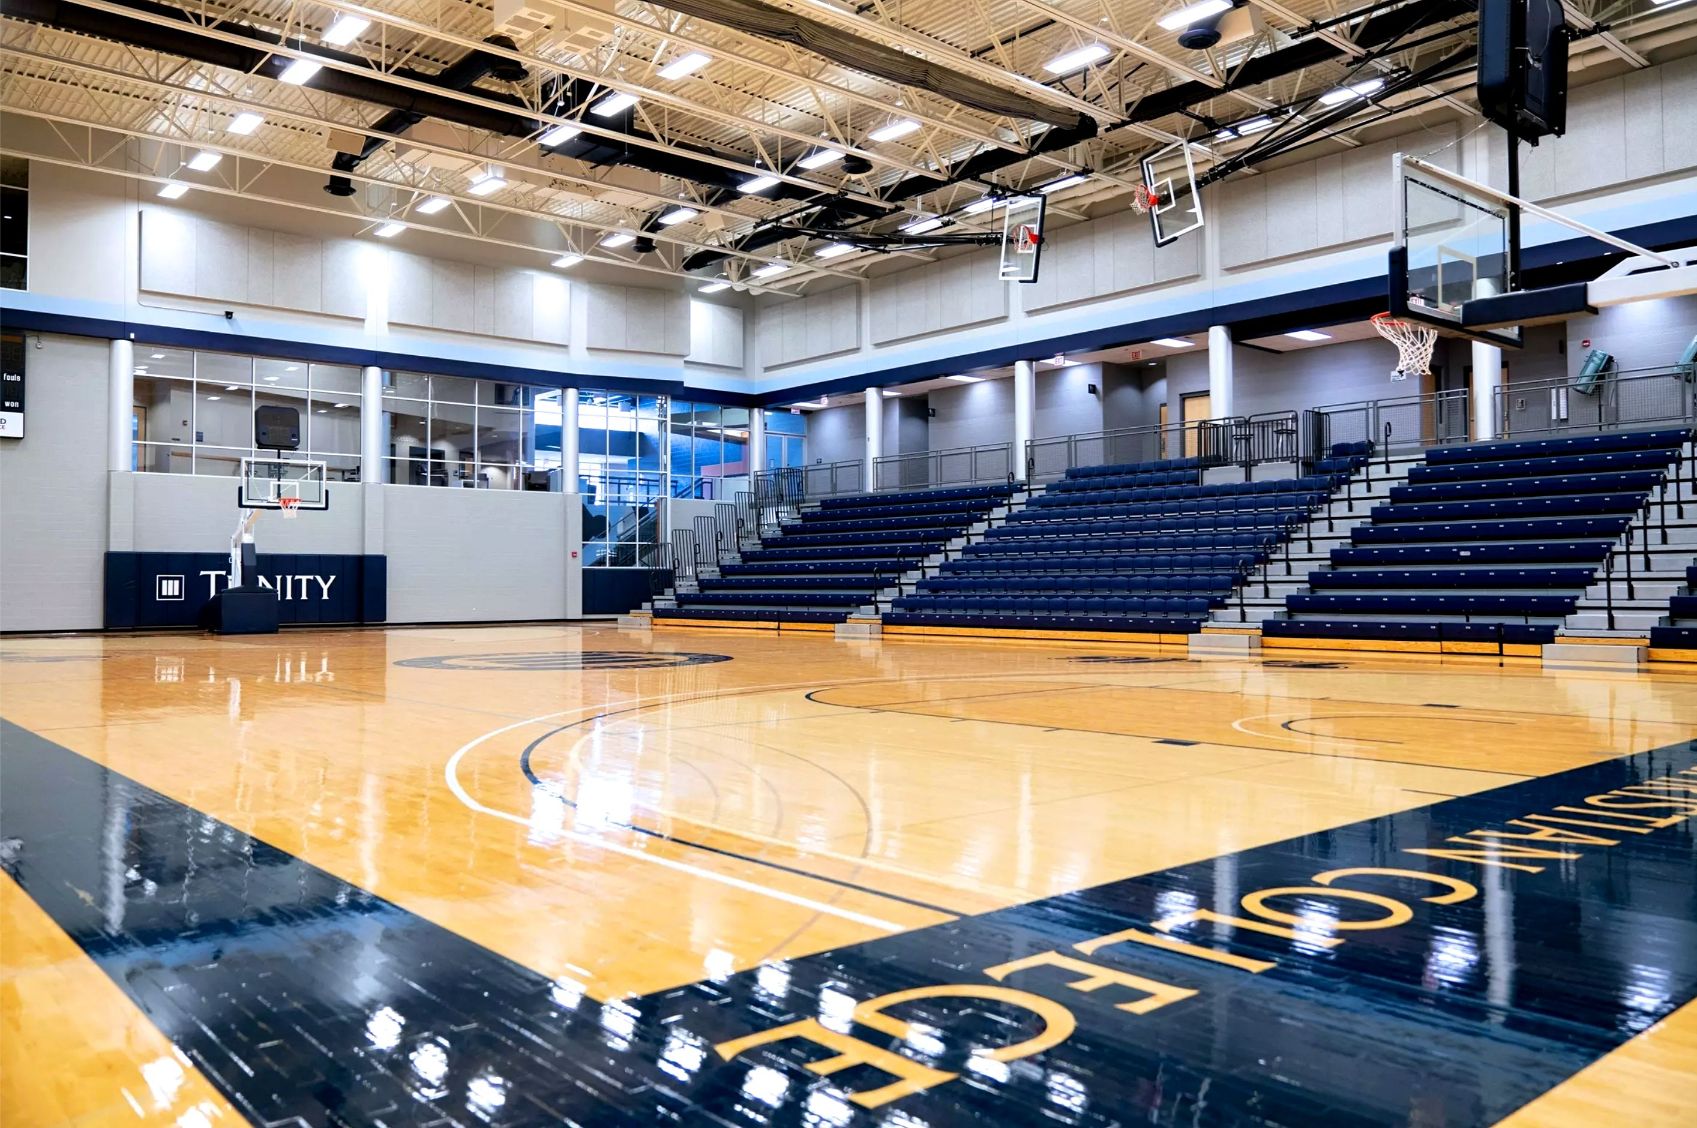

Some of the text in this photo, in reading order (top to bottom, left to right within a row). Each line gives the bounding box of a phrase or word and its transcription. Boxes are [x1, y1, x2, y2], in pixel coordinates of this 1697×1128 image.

[3, 373, 21, 382] fouls
[200, 570, 337, 601] TNITY
[714, 867, 1478, 1109] COLLEGE
